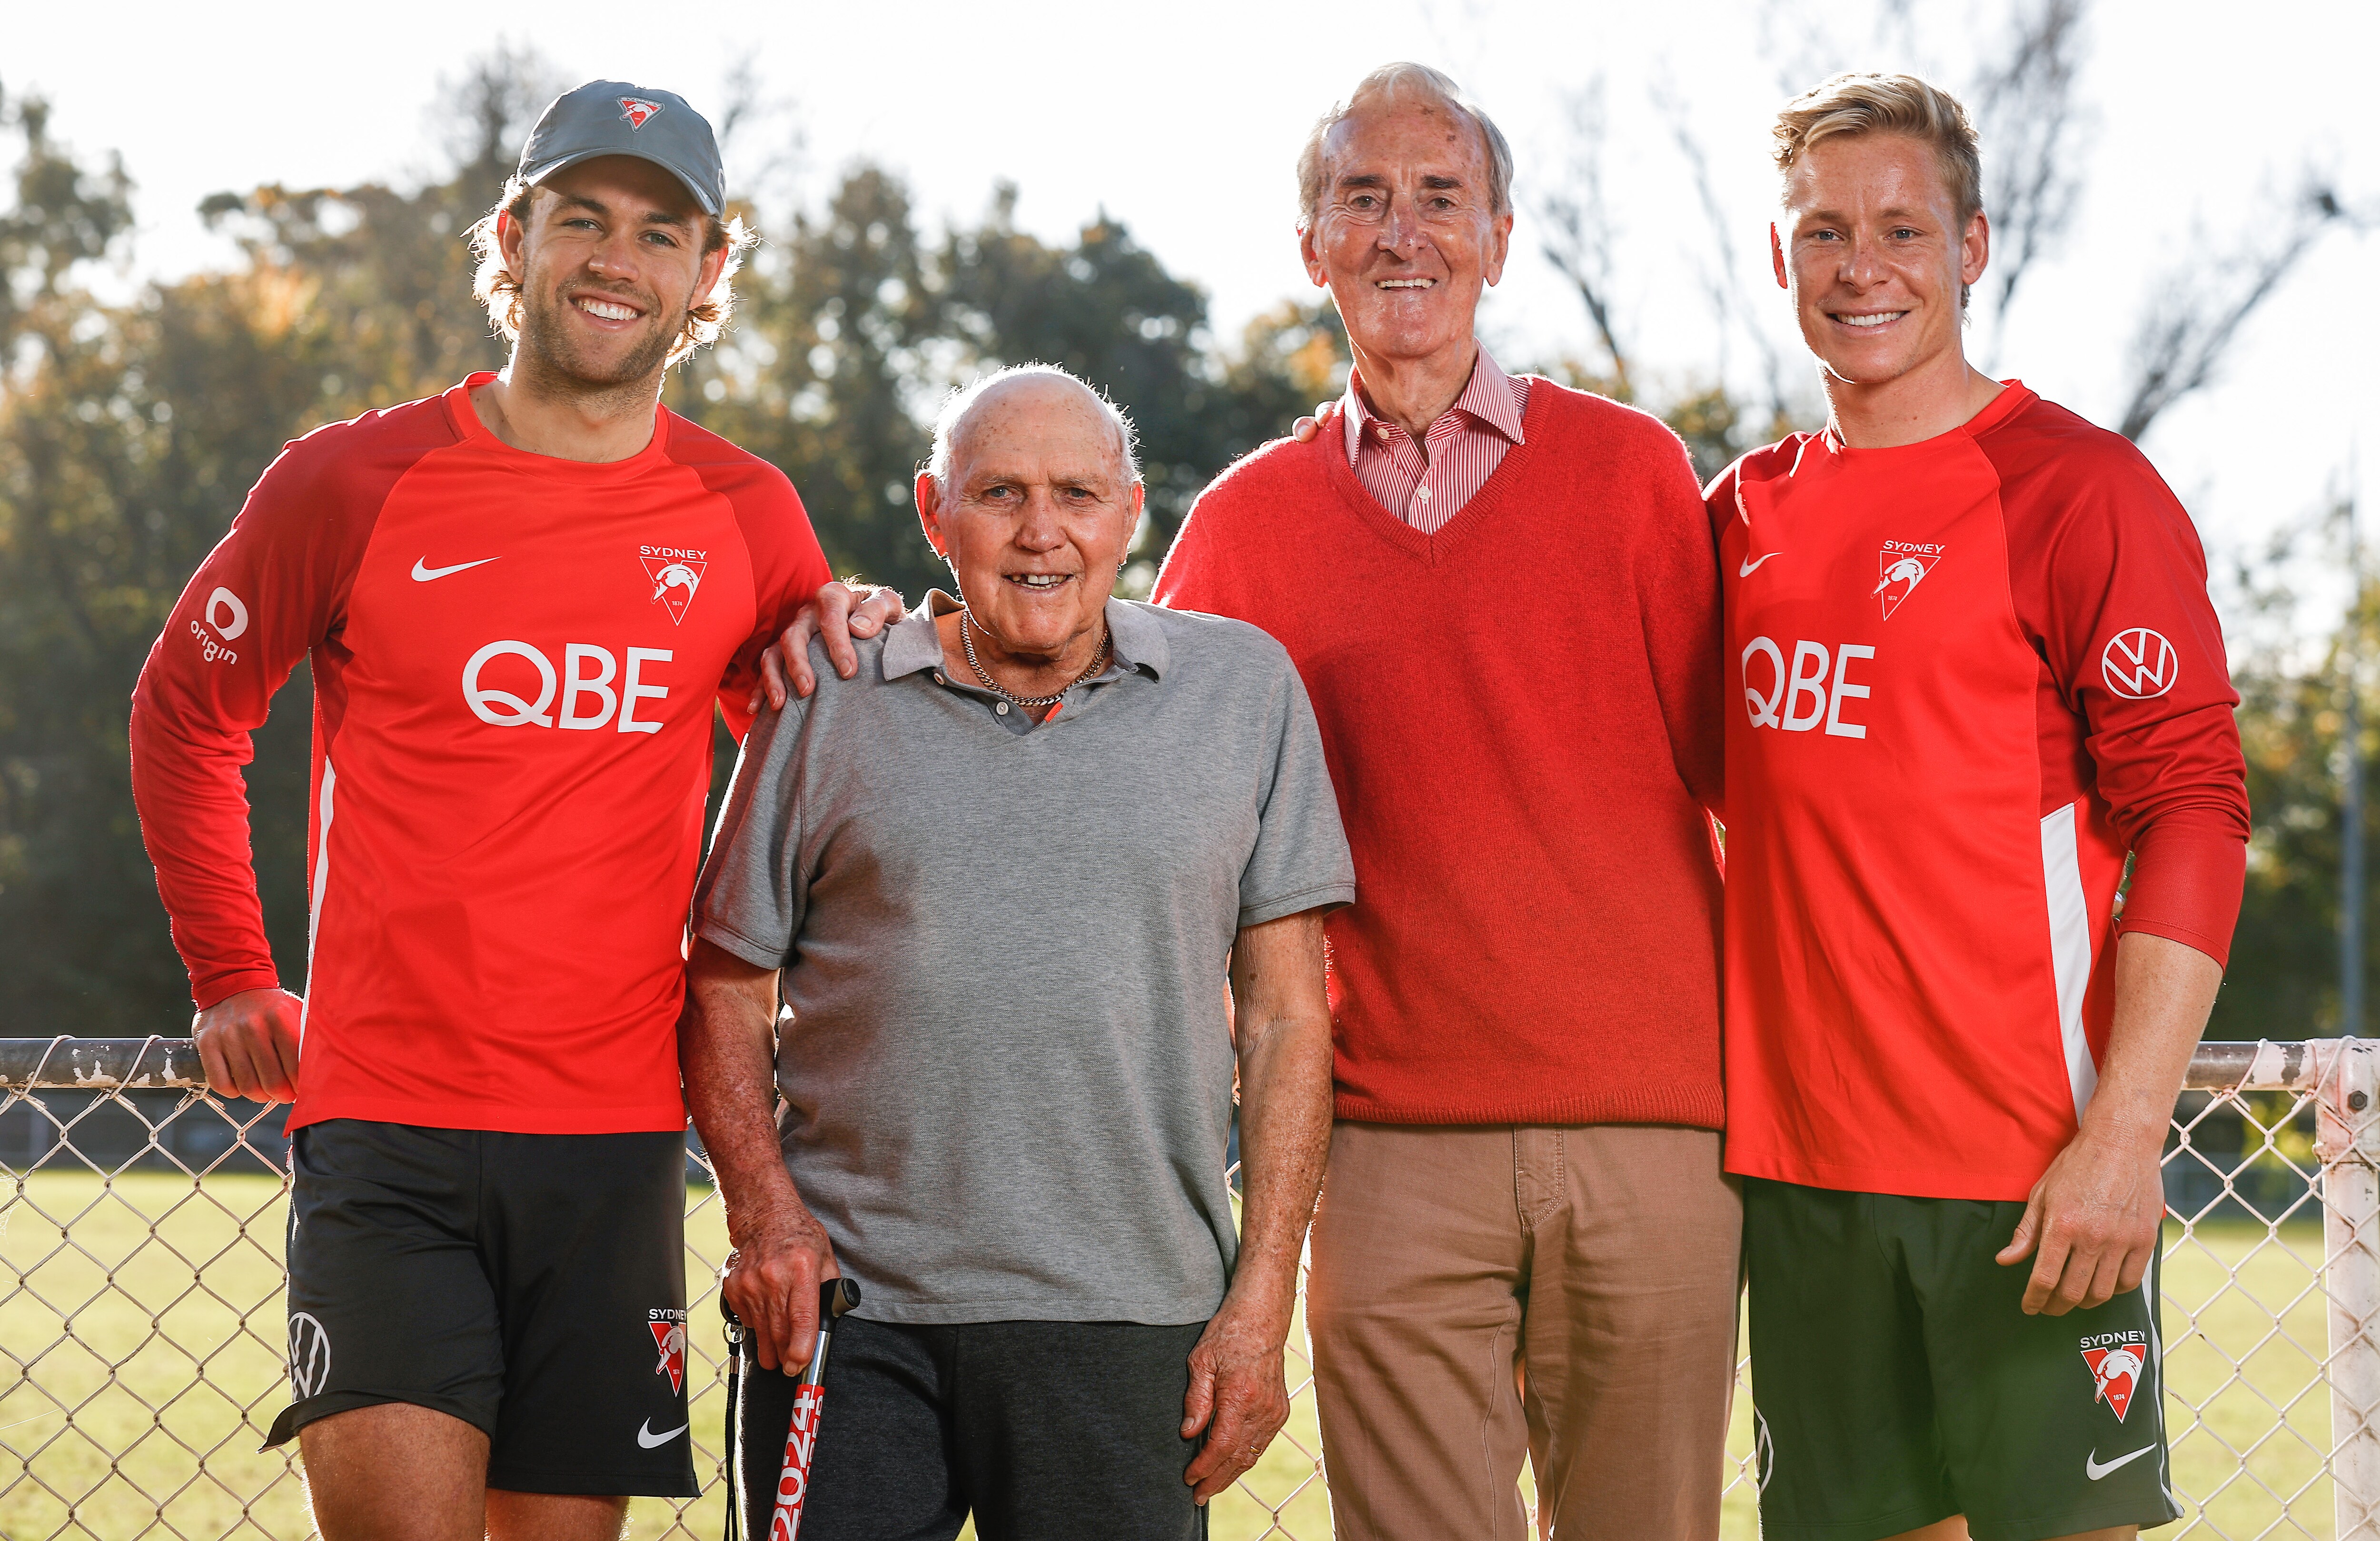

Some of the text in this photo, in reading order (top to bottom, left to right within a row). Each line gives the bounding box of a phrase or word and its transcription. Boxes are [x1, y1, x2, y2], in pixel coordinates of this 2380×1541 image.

[621, 97, 661, 107] SYDNEY
[640, 545, 707, 560] SYDNEY
[1883, 540, 1945, 554] SYDNEY
[190, 620, 238, 665] origin
[462, 640, 673, 734] QBE
[1741, 636, 1876, 739] QBE
[2080, 1330, 2145, 1348] SYDNEY
[769, 1391, 815, 1541] 2024
